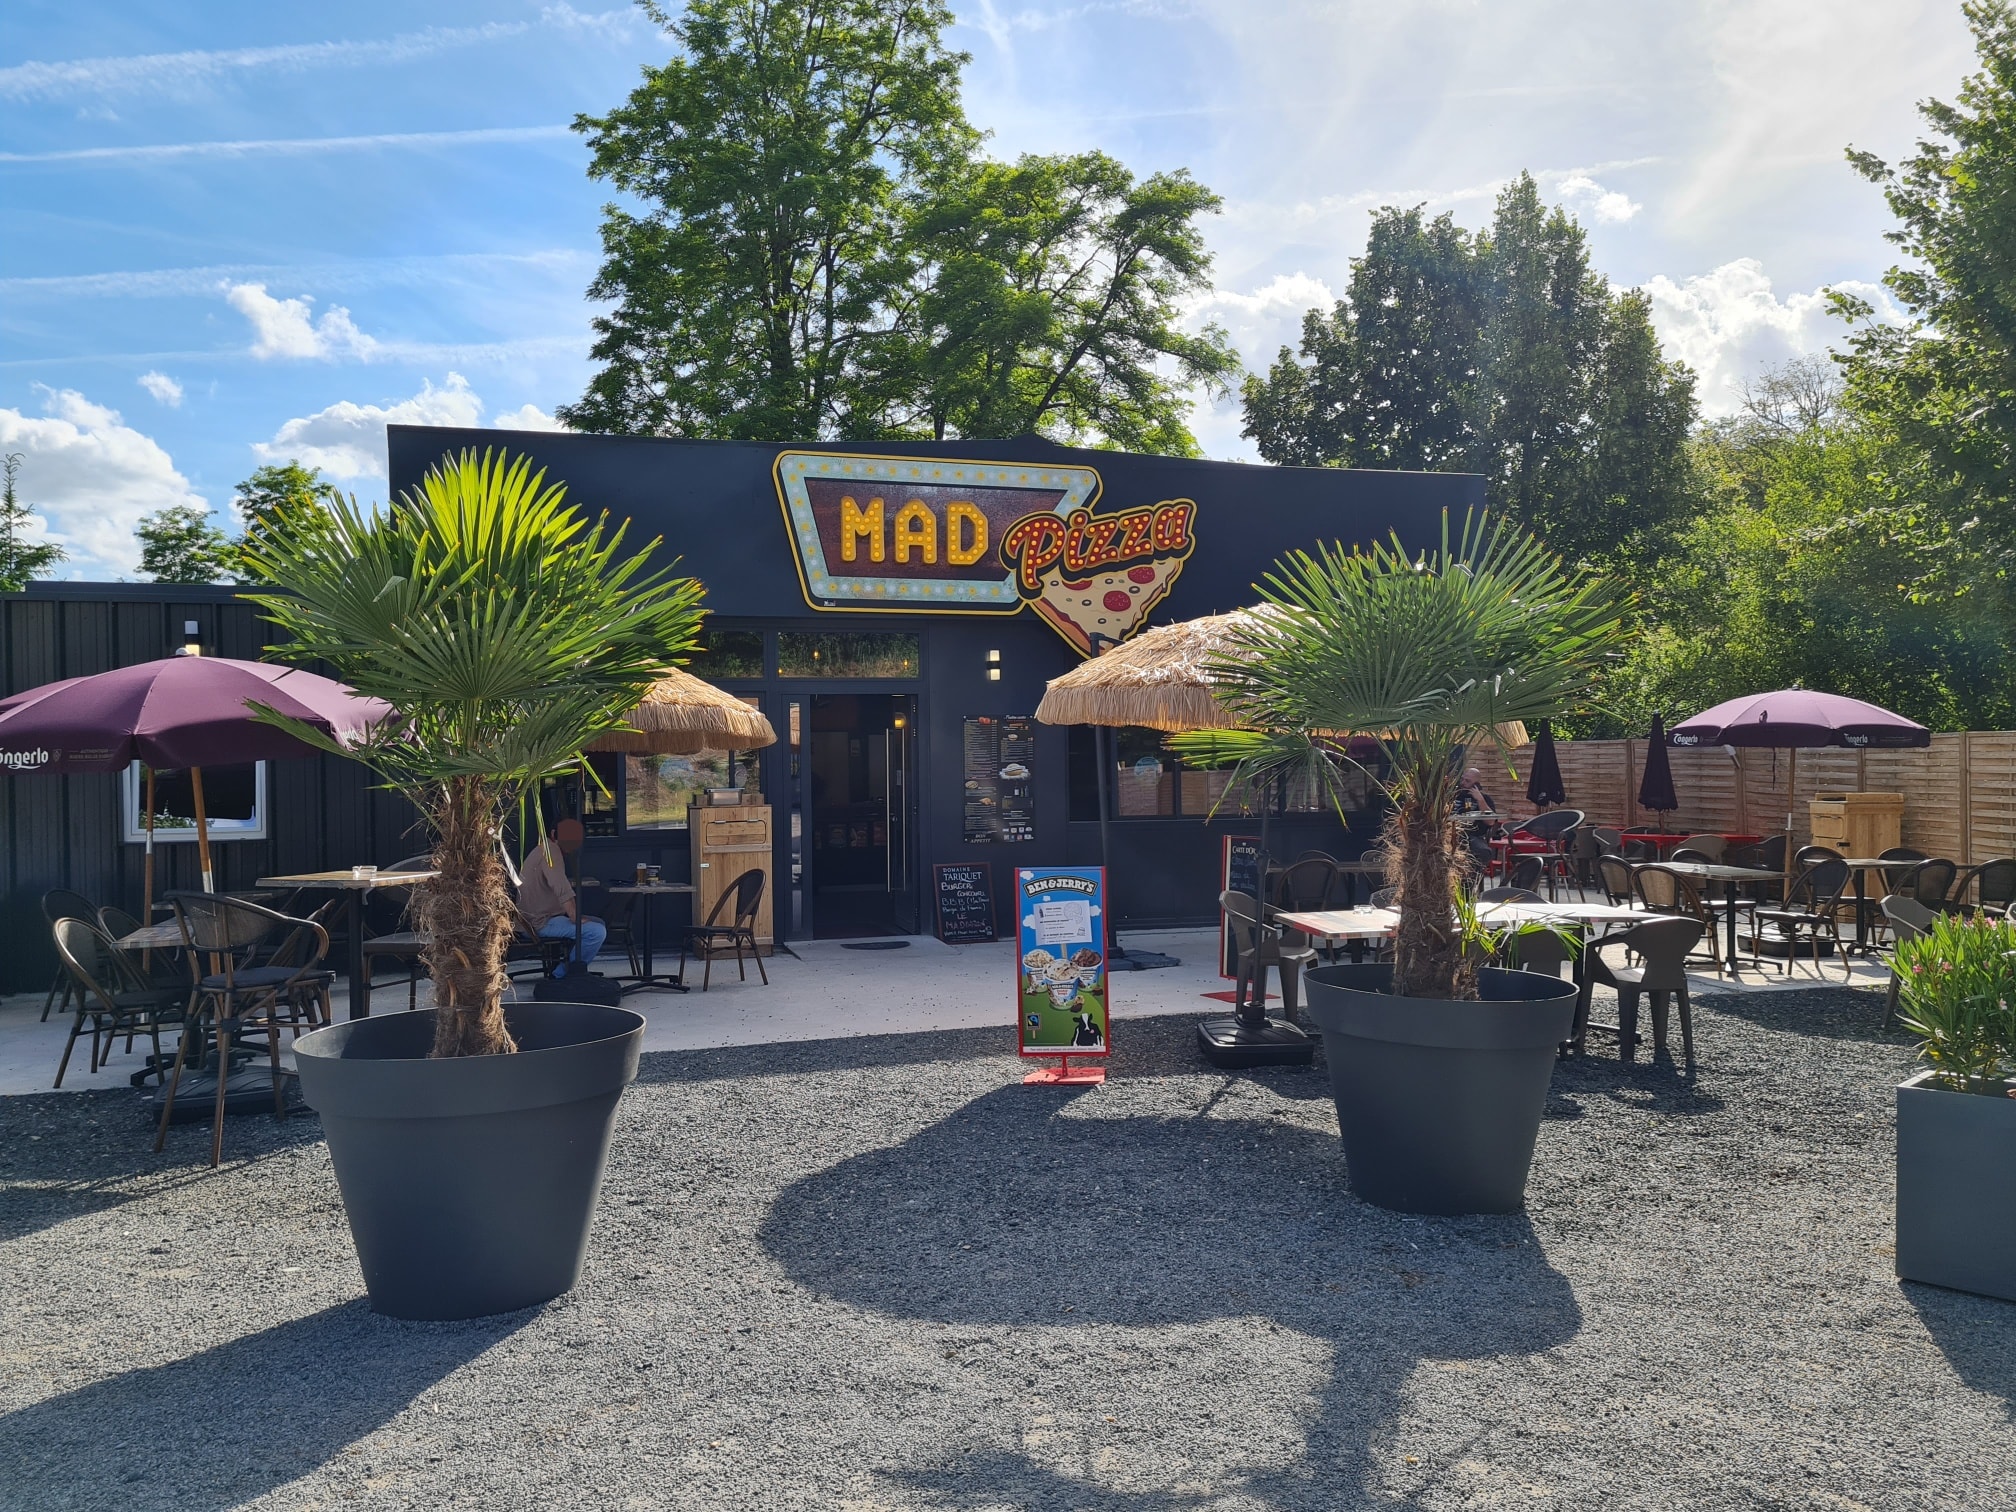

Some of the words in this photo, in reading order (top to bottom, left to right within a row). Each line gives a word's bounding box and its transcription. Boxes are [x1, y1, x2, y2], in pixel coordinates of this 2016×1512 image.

[840, 495, 989, 566] MAD
[1005, 503, 1190, 590] Pizza
[0, 747, 49, 770] ongerlo
[943, 872, 982, 883] TARIQUET
